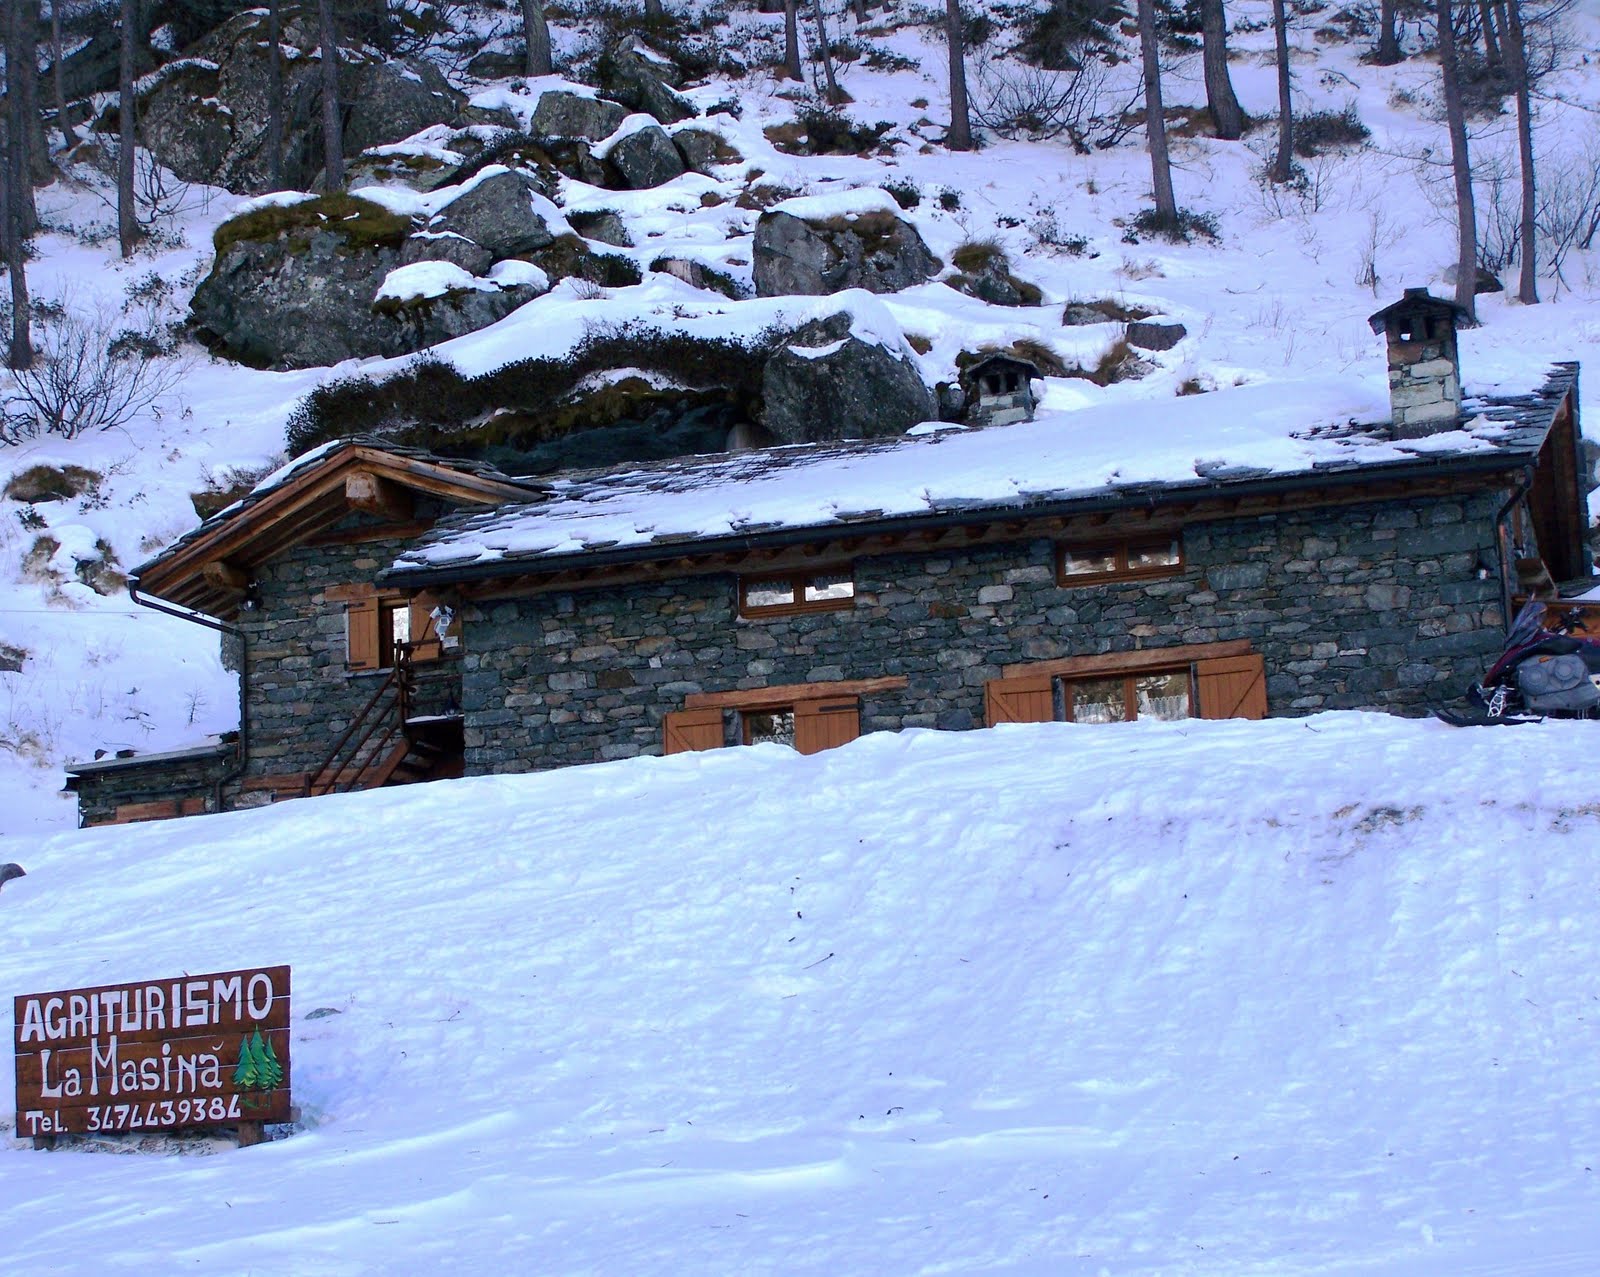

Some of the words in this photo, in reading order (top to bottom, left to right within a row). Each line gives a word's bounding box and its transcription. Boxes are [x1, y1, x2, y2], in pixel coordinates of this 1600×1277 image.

[20, 973, 274, 1043] AGRITURISMO
[40, 1048, 83, 1098] La
[86, 1094, 242, 1132] 3474439384
